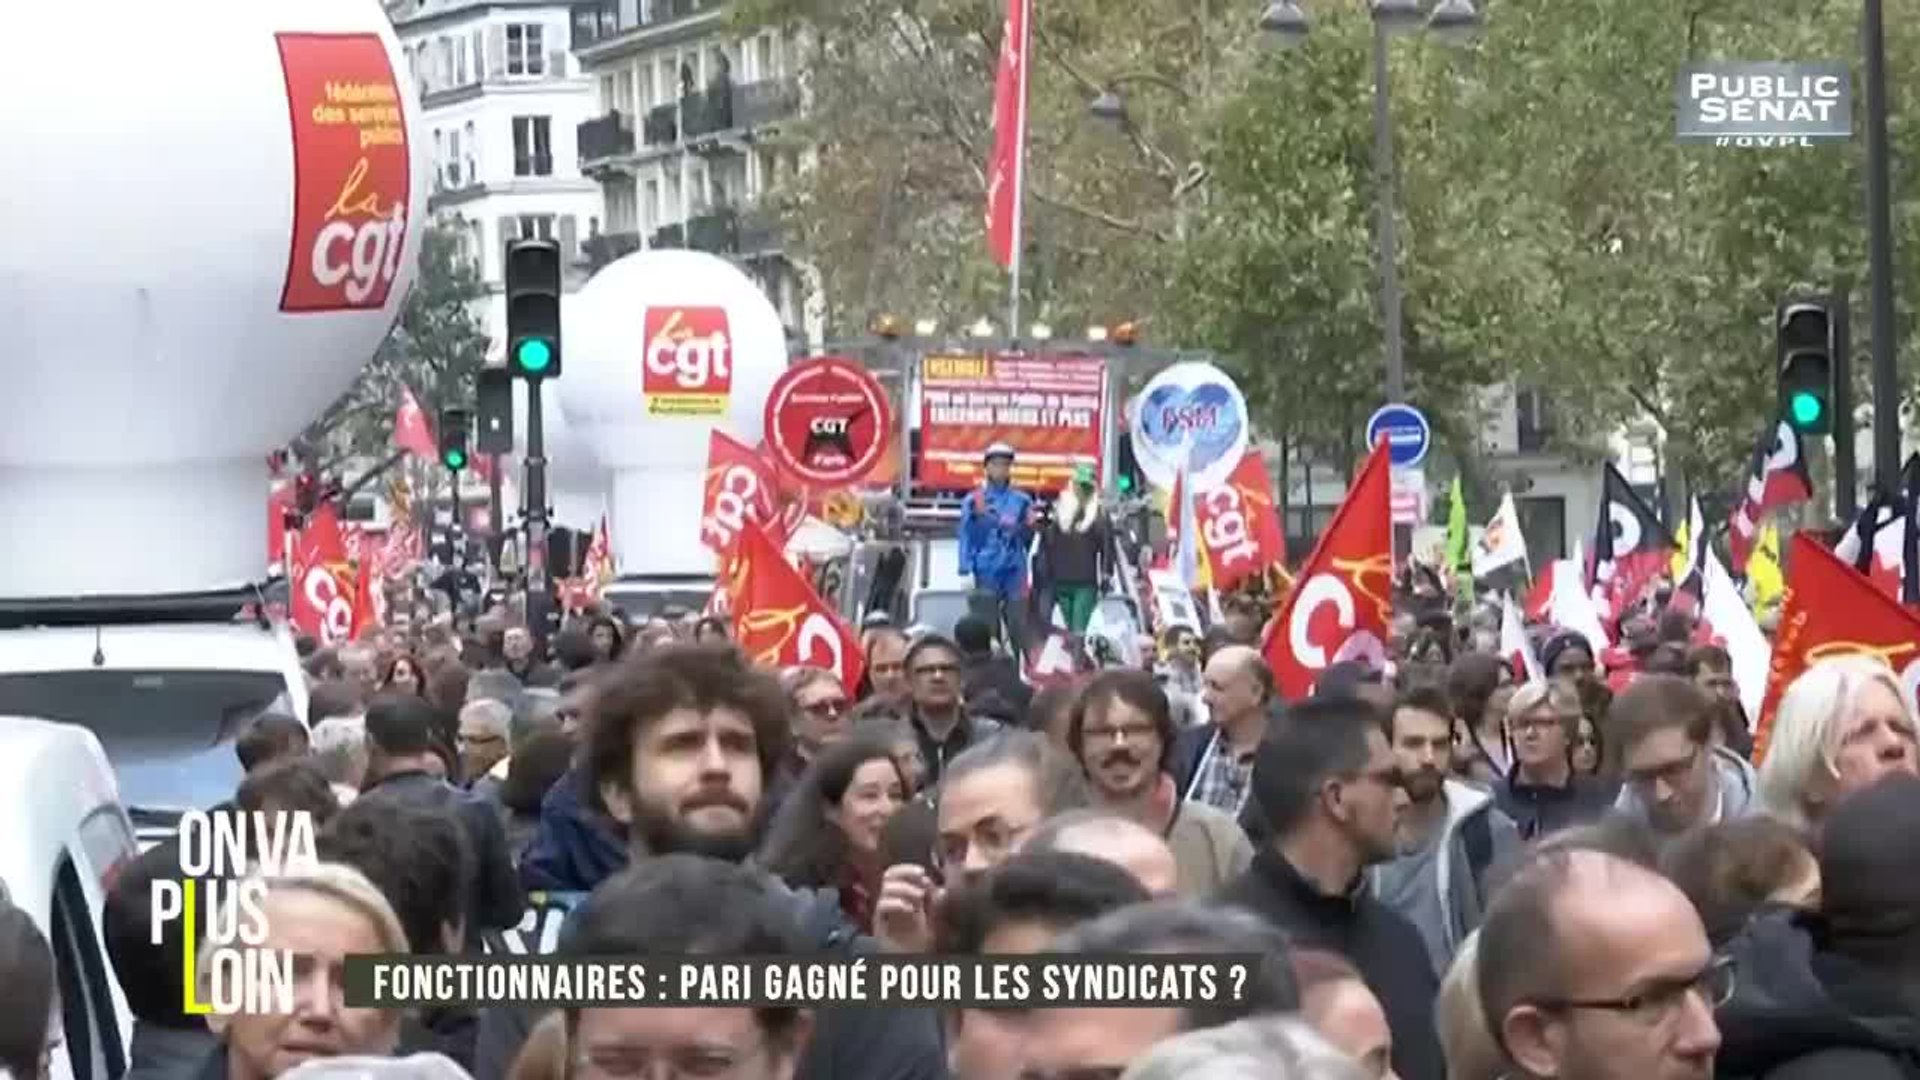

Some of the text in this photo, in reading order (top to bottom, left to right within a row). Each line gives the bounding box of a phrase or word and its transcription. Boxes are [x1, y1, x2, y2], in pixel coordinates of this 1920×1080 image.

[324, 157, 388, 221] la
[312, 201, 404, 303] cgt
[646, 329, 731, 388] cgt
[810, 416, 850, 434] CGT
[1203, 484, 1260, 567] cgt
